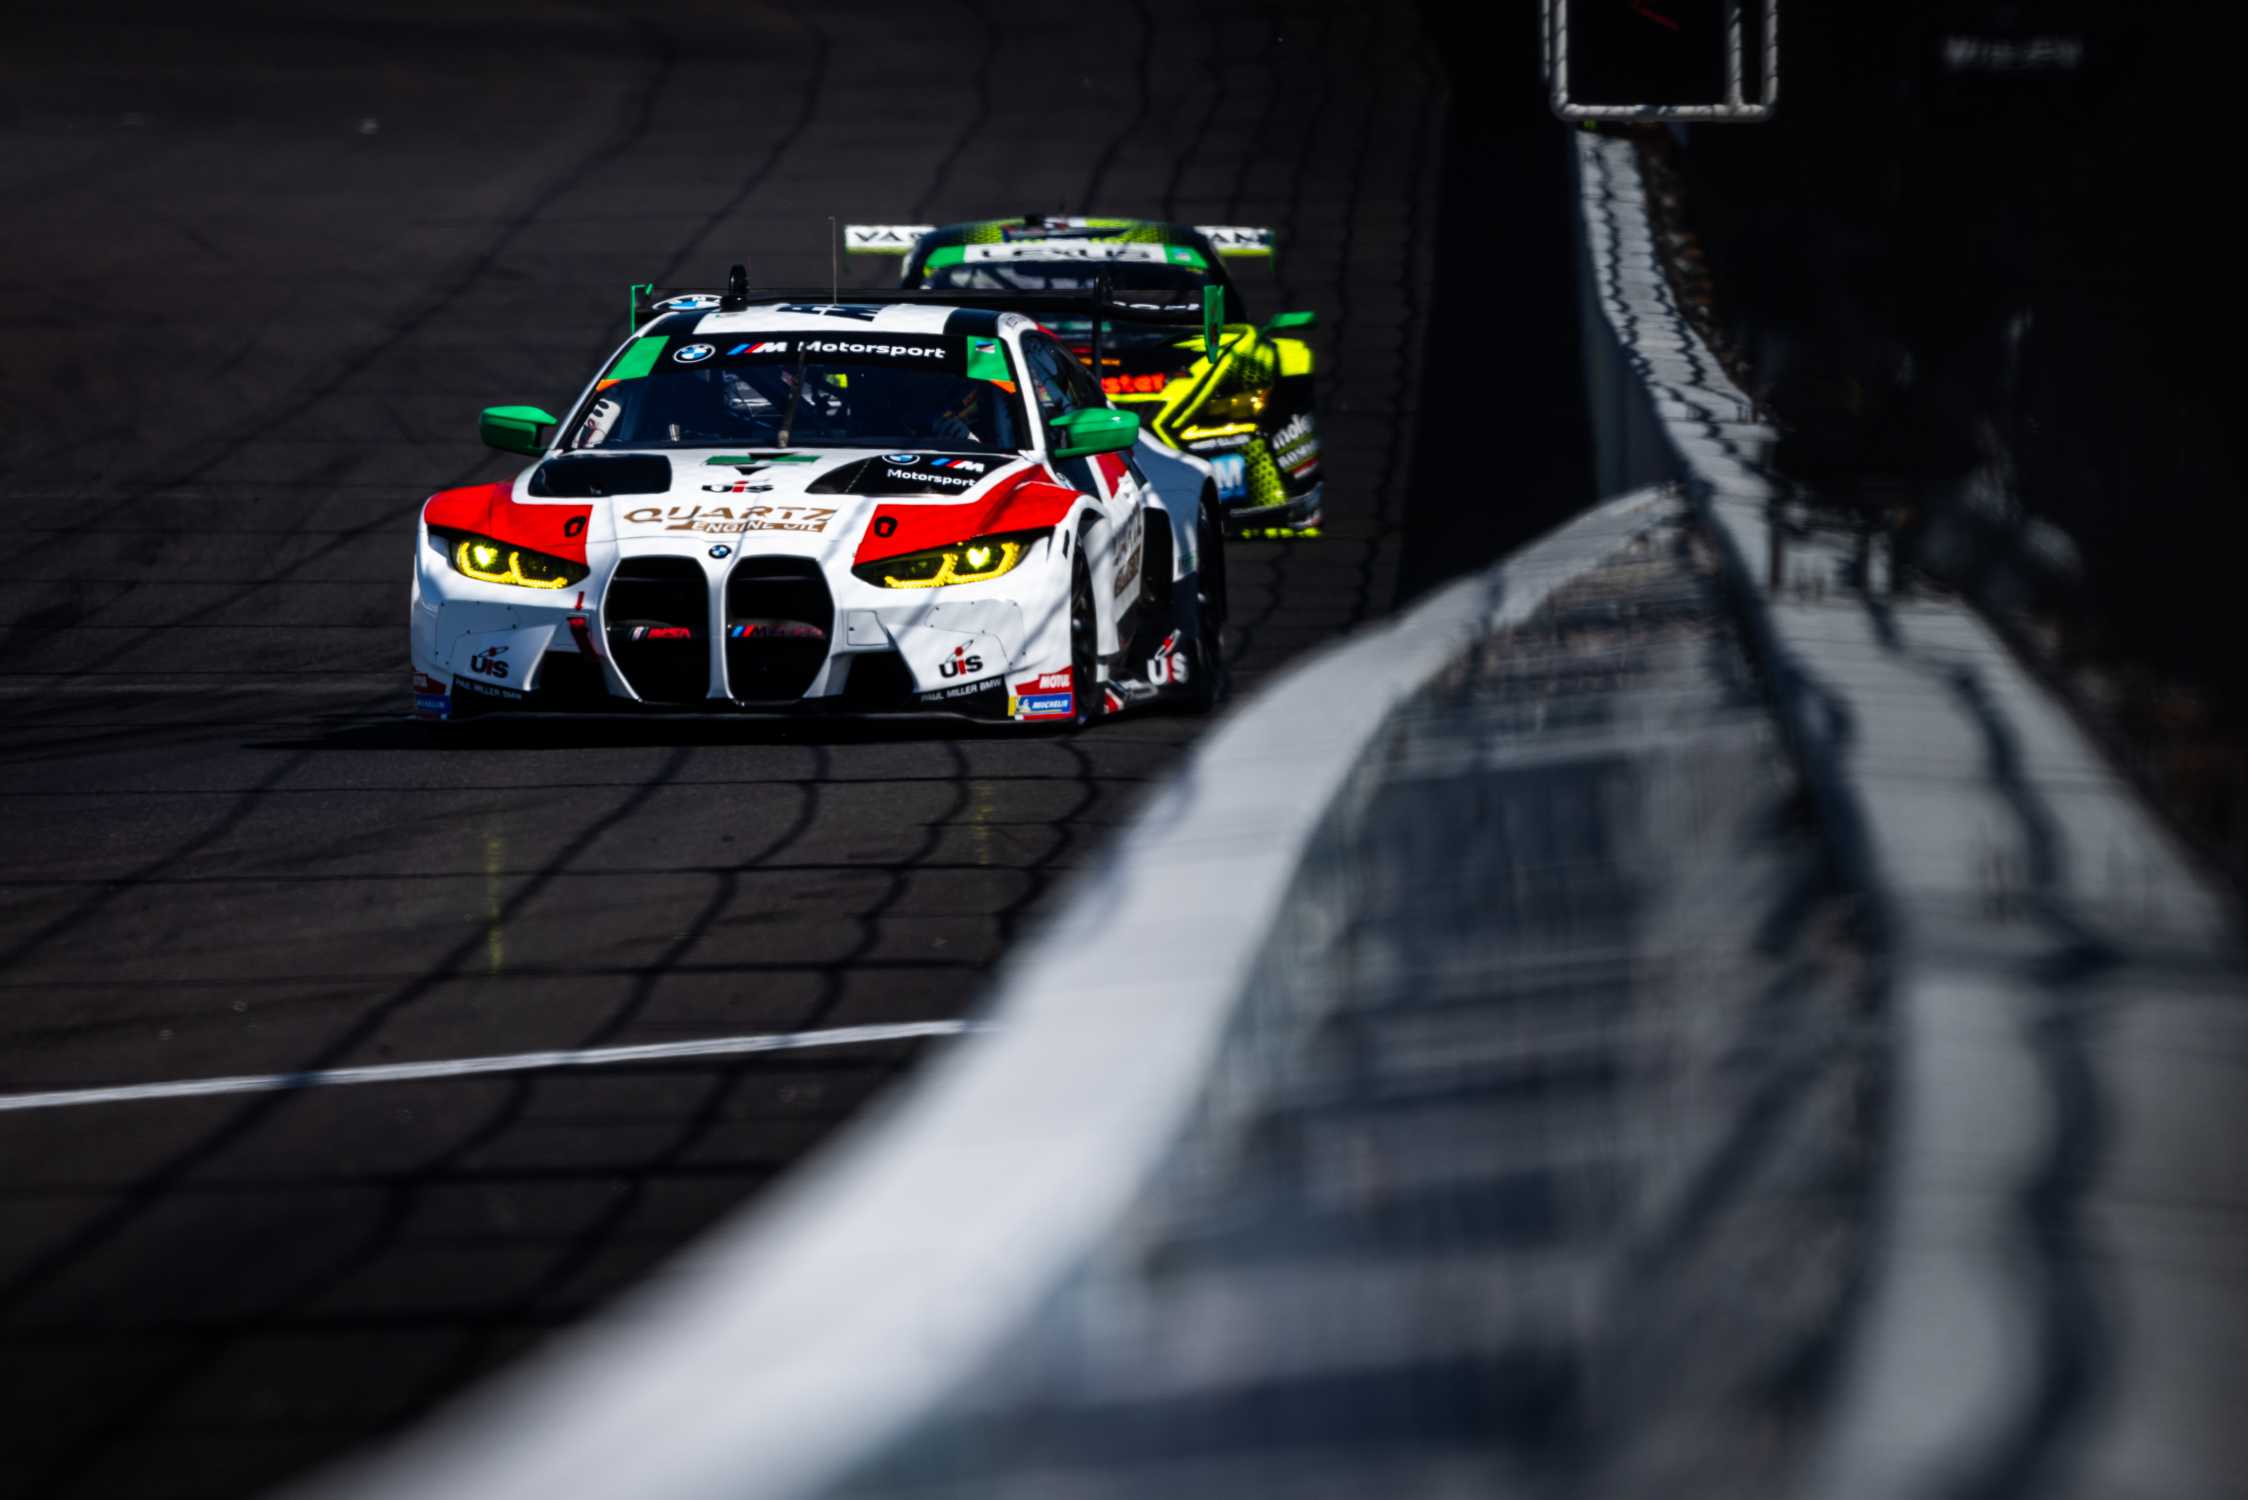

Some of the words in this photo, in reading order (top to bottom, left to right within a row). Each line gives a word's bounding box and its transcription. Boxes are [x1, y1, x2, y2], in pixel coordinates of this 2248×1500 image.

[797, 339, 947, 359] Motorsport
[886, 468, 979, 487] Motorsport
[624, 505, 838, 523] QUARTZ
[691, 519, 775, 533] ENGINE
[946, 684, 979, 698] MILLER
[980, 678, 1003, 692] BMW
[1039, 674, 1071, 690] MOTUL
